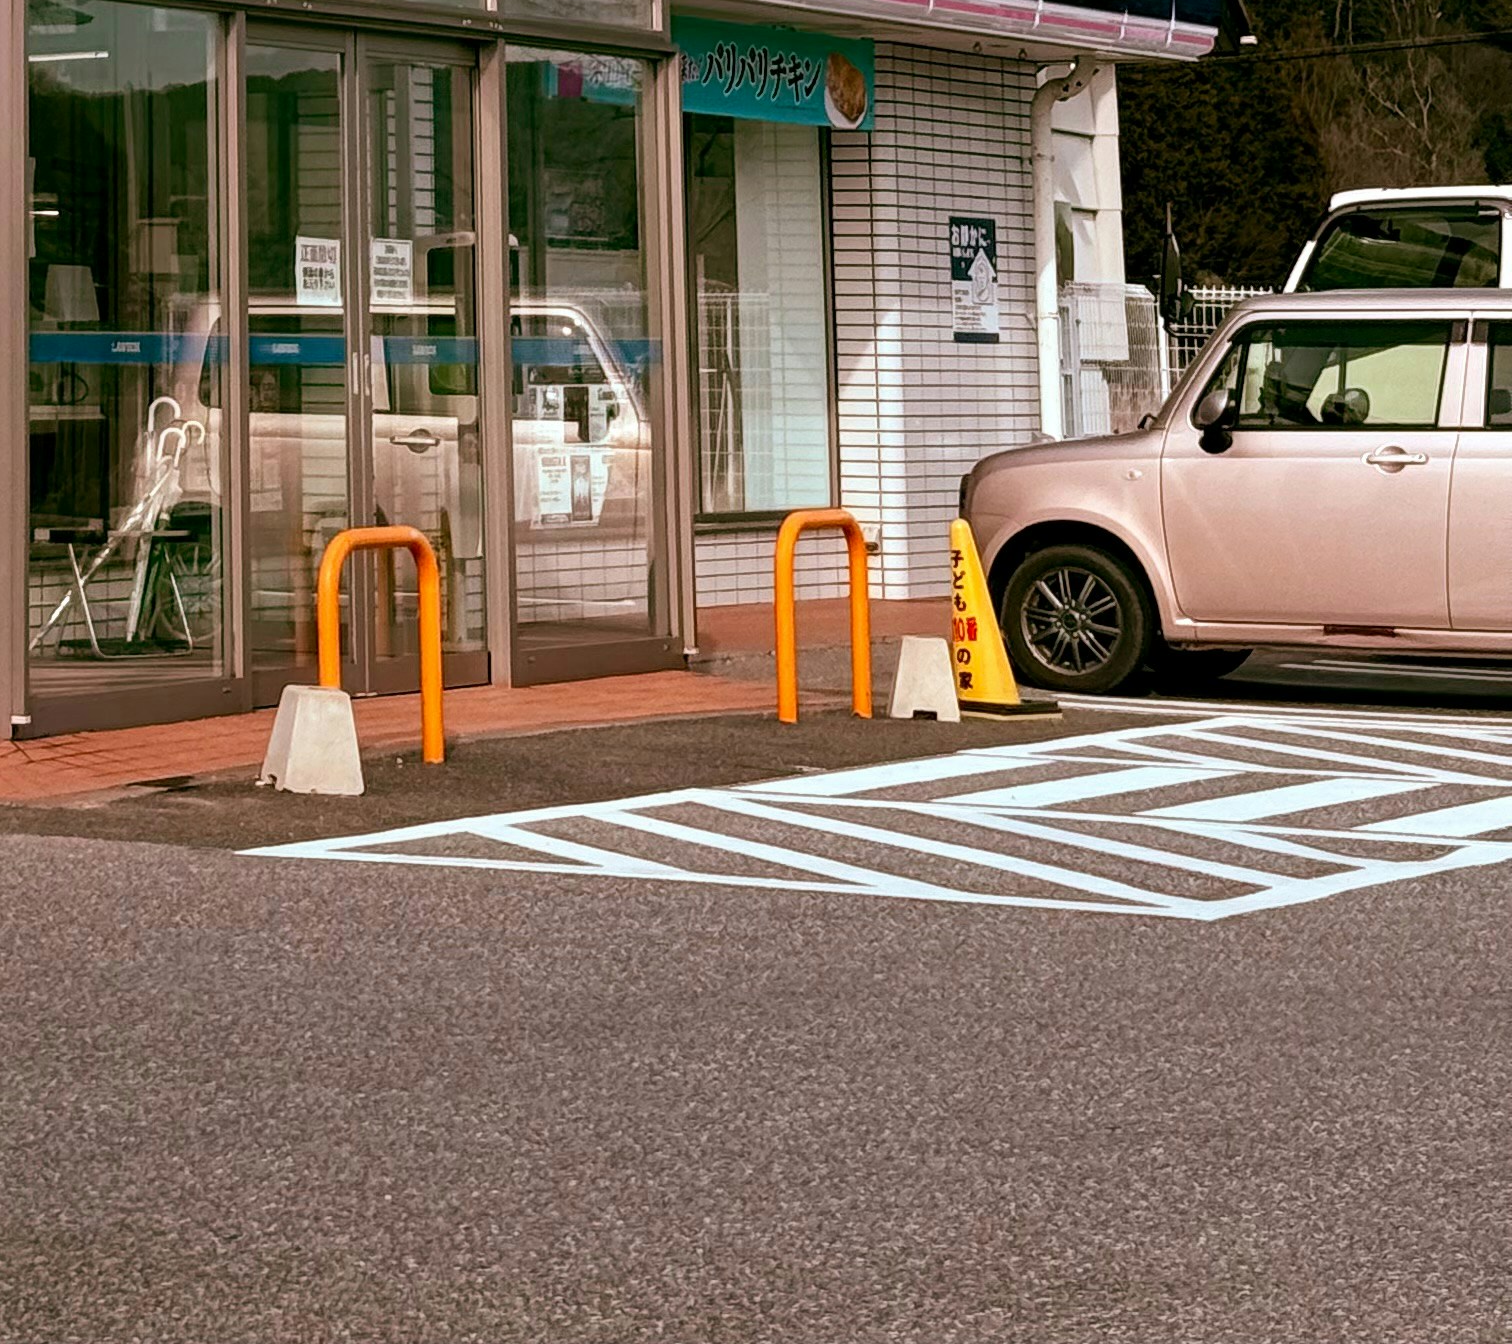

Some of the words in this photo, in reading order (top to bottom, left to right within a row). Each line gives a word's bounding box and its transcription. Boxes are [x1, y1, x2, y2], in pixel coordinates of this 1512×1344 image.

[701, 40, 822, 105] パリパリチキン
